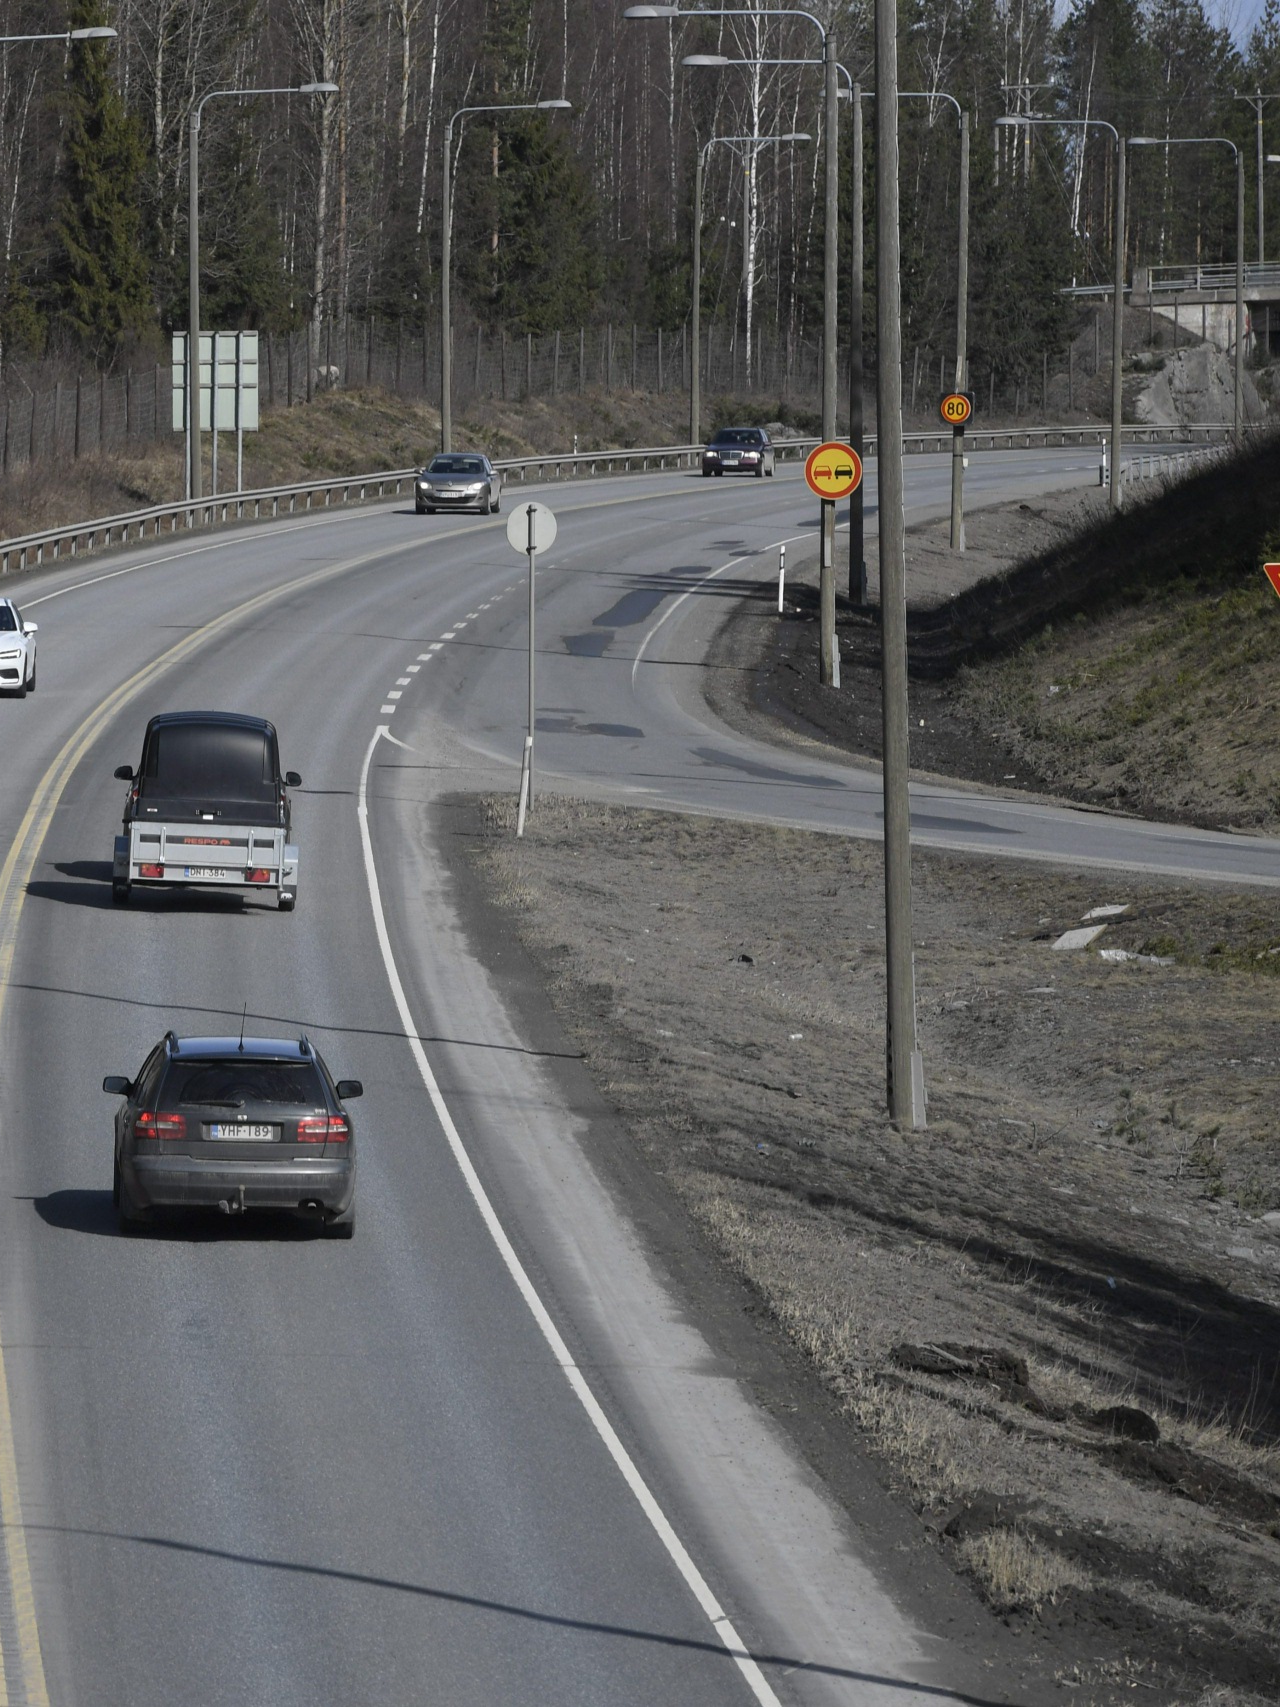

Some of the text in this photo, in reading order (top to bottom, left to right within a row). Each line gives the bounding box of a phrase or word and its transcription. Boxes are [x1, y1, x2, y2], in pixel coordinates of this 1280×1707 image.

[947, 402, 964, 416] 80
[183, 837, 219, 845] RESPO
[220, 1124, 269, 1138] YHF-189
